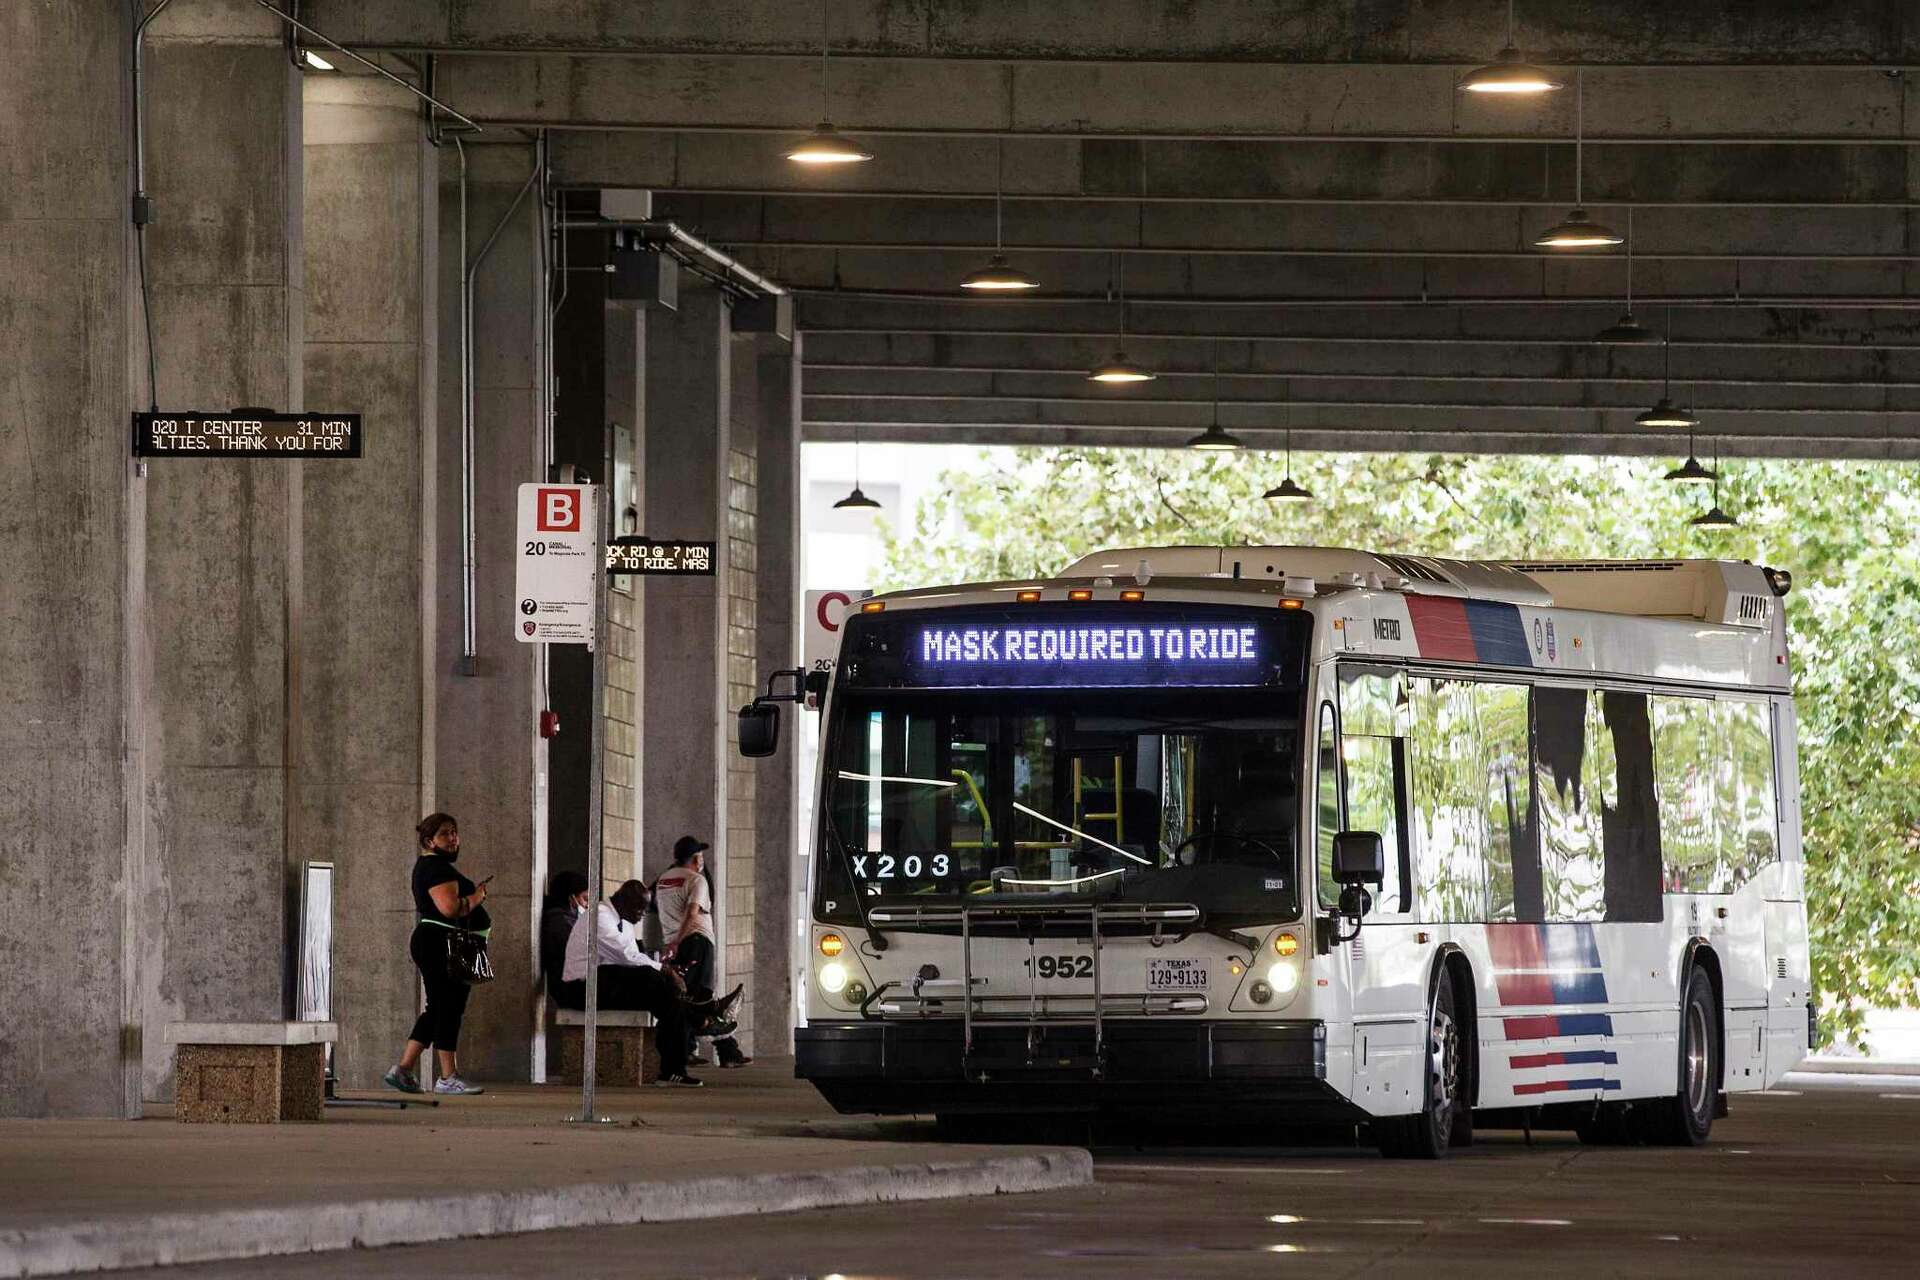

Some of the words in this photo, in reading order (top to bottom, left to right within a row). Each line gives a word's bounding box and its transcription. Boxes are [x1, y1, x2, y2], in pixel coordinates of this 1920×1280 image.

[152, 420, 177, 435] 020
[185, 421, 195, 435] T
[203, 421, 262, 435] CENTER
[297, 421, 313, 435] 31
[321, 422, 351, 435] MIN
[218, 436, 267, 450] THANK
[275, 436, 306, 450] YOU
[313, 436, 343, 450] FOR
[547, 494, 574, 527] B
[525, 541, 546, 556] 20
[631, 546, 647, 558] RD
[673, 547, 681, 558] 7
[686, 547, 709, 558] MIN
[622, 558, 639, 569] TO
[644, 558, 677, 569] RIDE.
[817, 592, 850, 631] C
[1373, 618, 1401, 640] METRO
[923, 631, 999, 661] MASK
[1005, 630, 1144, 660] REQUIRED
[1150, 629, 1183, 659] TO
[1190, 628, 1256, 659] RIDE
[852, 853, 949, 878] X203
[825, 901, 837, 913] P
